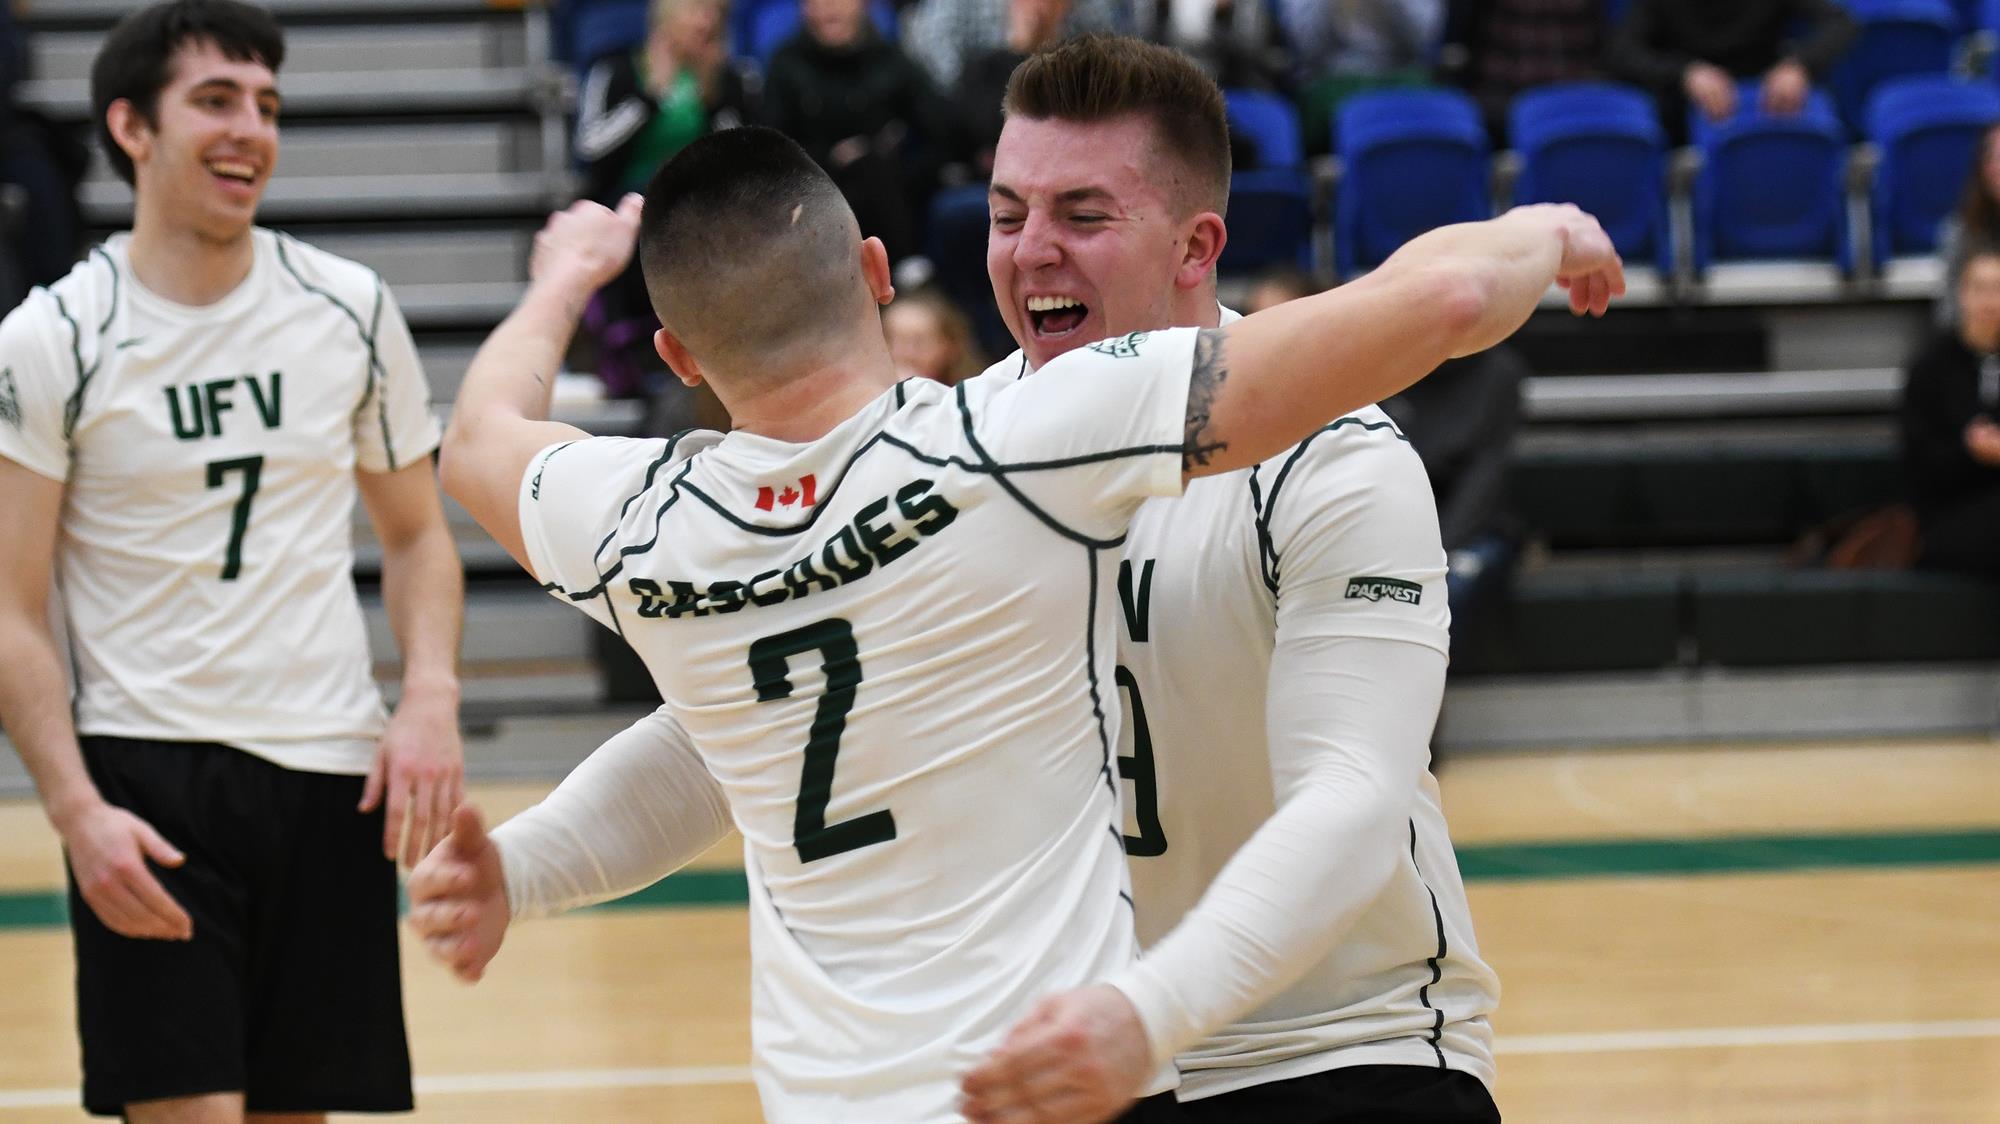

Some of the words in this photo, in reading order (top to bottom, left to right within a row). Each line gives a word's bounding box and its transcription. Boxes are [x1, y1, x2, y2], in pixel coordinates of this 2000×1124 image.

[164, 371, 282, 440] UFV
[206, 455, 264, 581] 7
[628, 478, 959, 619] CASCADES
[1346, 582, 1420, 603] PACWEST
[748, 617, 897, 864] 2
